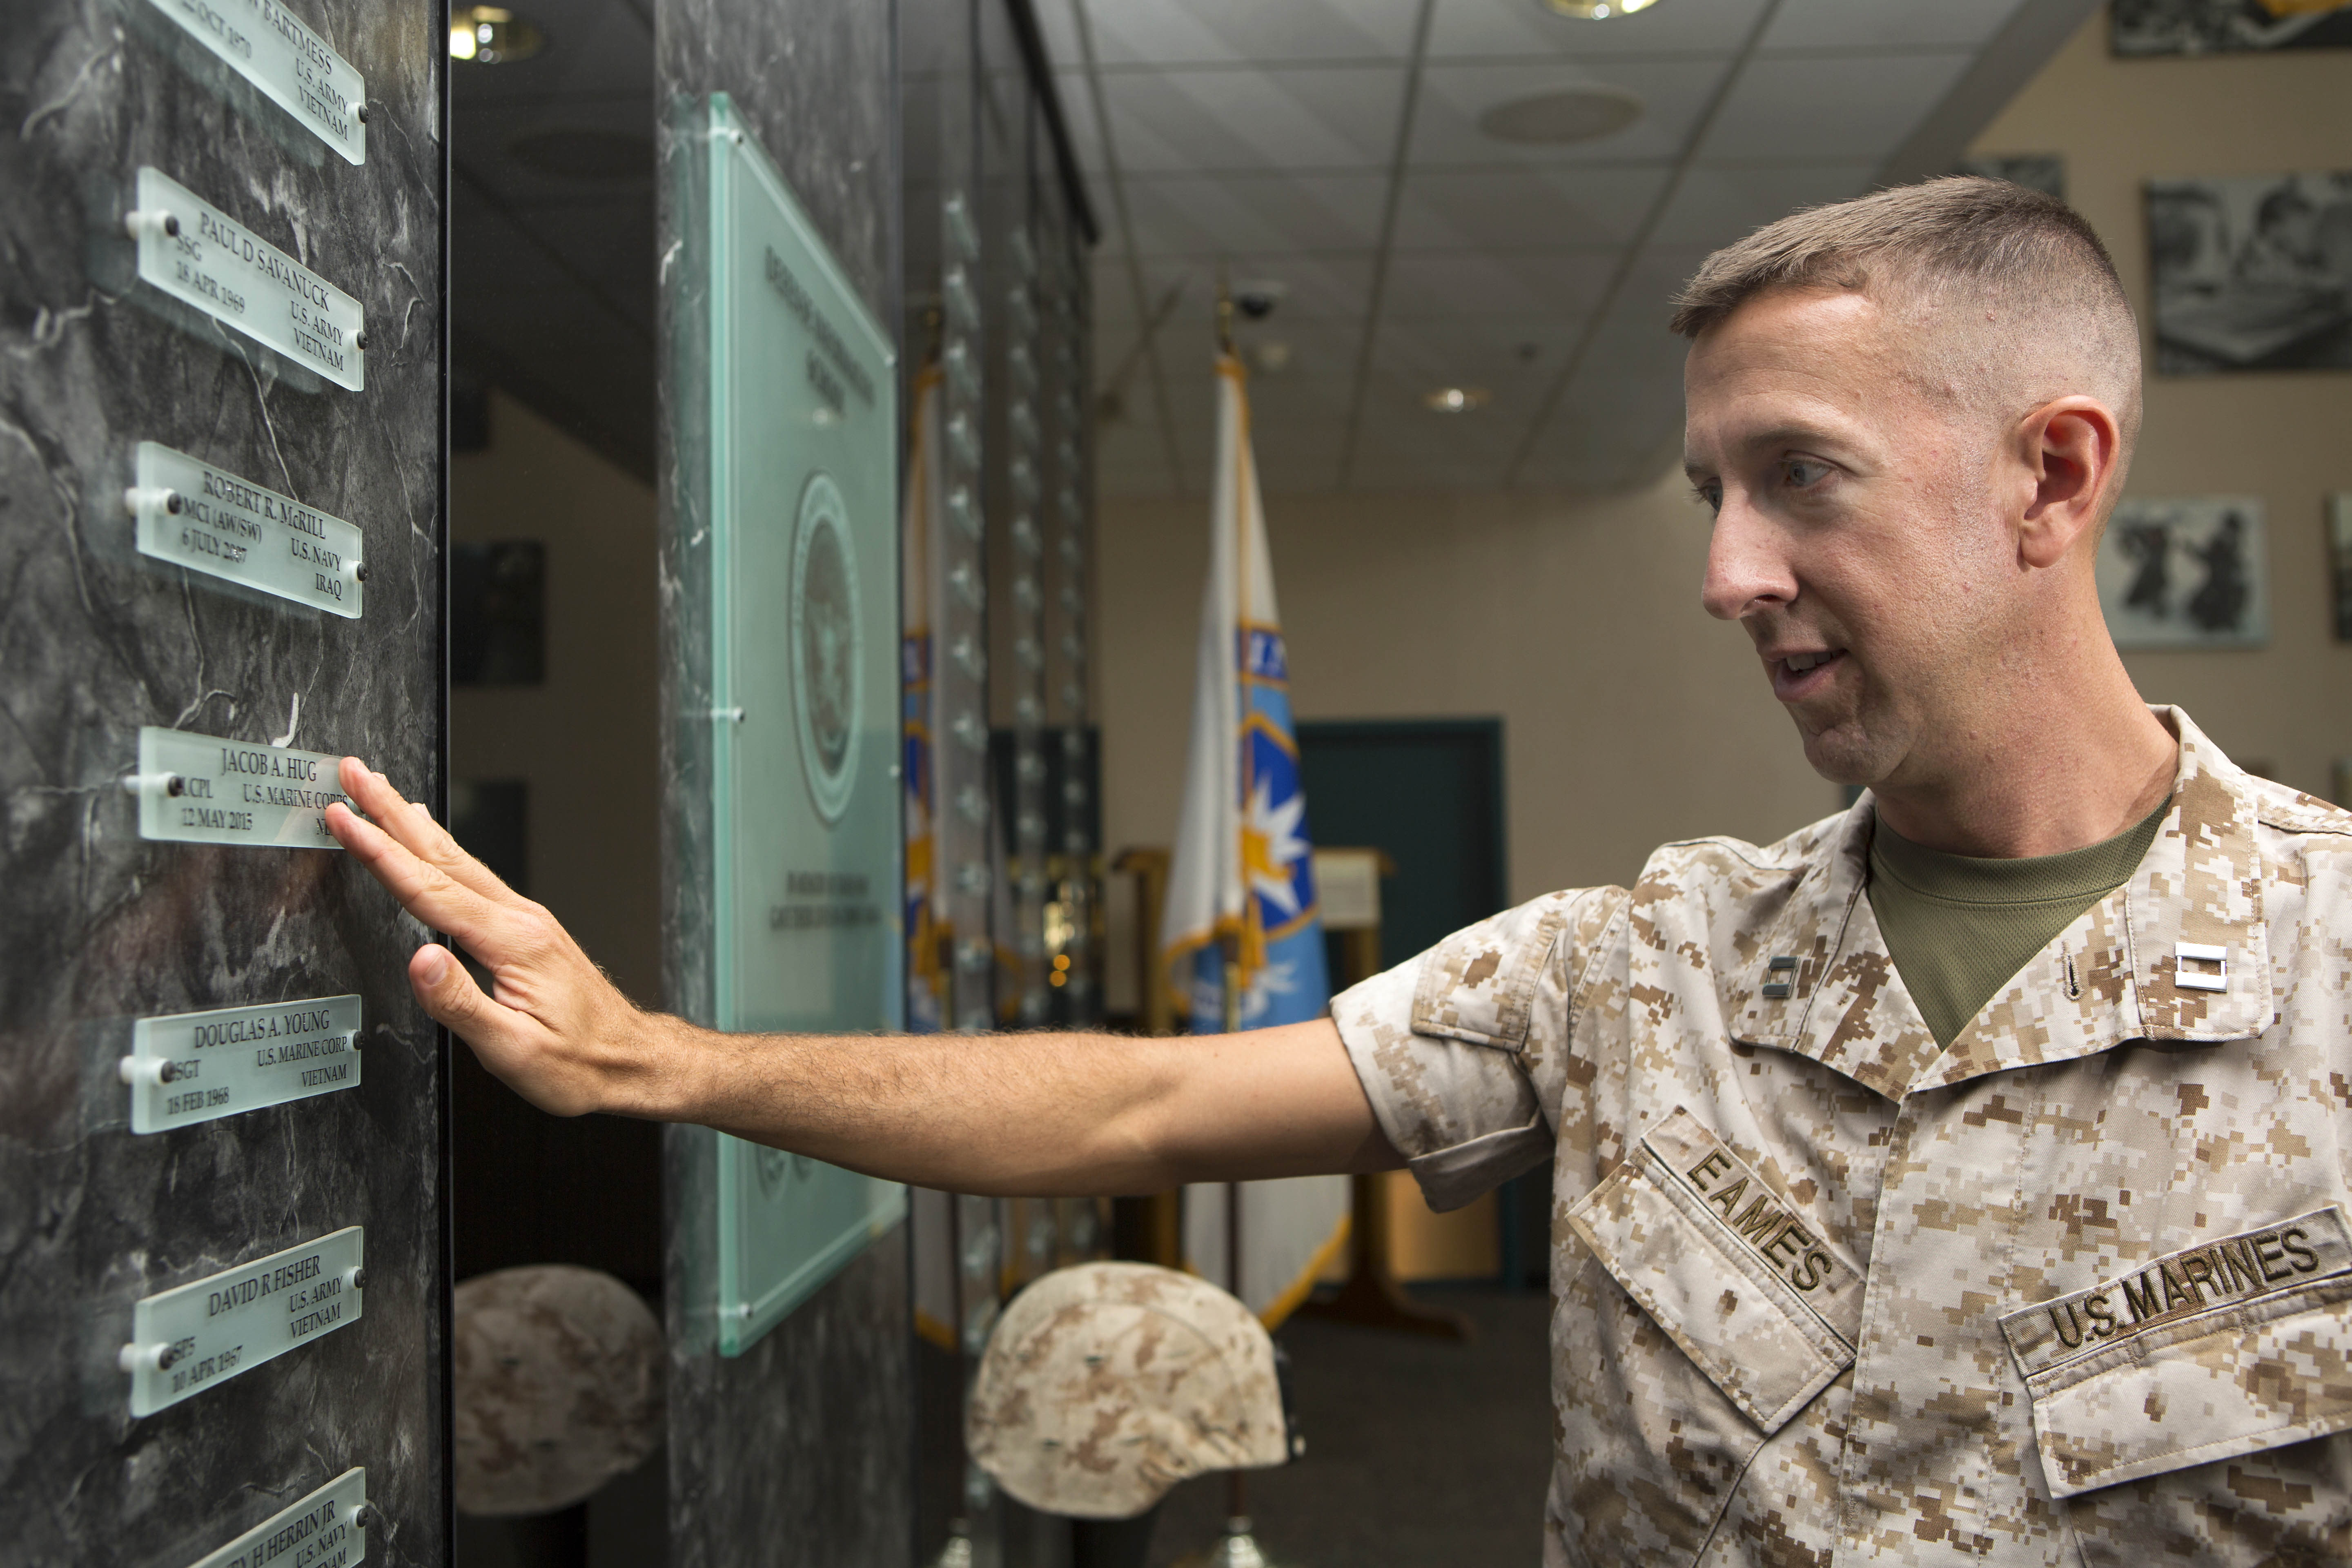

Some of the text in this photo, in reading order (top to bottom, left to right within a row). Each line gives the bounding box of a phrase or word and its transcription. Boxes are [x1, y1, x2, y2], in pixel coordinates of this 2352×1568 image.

[265, 0, 331, 75] BARTMESS
[296, 58, 348, 116] U.S. ARMY
[298, 86, 348, 141] VIETNAM
[200, 212, 330, 312] PAUL D SAVANUCK
[194, 271, 219, 300] APR
[222, 287, 245, 313] 1969
[291, 301, 343, 347] U.S. ARMY
[294, 328, 344, 372] VIETNAM
[203, 471, 326, 540] ROBERT R. McRILL
[182, 527, 190, 546] 6
[191, 529, 221, 556] JULY
[213, 508, 262, 545] (AW/SW)
[291, 537, 342, 572] U.S. NAVY
[316, 573, 342, 601] IRAQ
[221, 748, 316, 782] JACOB A. HUG
[243, 784, 265, 803] U.S.
[267, 786, 312, 808] MARINE
[182, 808, 253, 830] 12 MAY 2015
[194, 1009, 330, 1049] DOUGLAS A. YOUNG
[171, 1059, 201, 1080] SGT
[257, 1049, 276, 1067] U.S.
[278, 1040, 320, 1063] MARINE
[301, 1064, 347, 1087] VIETNAM
[183, 1091, 204, 1112] FEB
[207, 1087, 229, 1107] 1968
[1687, 1147, 1832, 1291] EAMES
[209, 1254, 321, 1317] DAVID R FISHER
[290, 1276, 343, 1313] U.S. ARMY
[290, 1302, 341, 1338] VIETNAM
[189, 1357, 215, 1386] APR
[253, 1544, 264, 1568] H
[267, 1508, 320, 1561] HERRIN
[322, 1500, 335, 1532] JR
[296, 1544, 315, 1568] U.S.
[318, 1521, 347, 1556] NAVY
